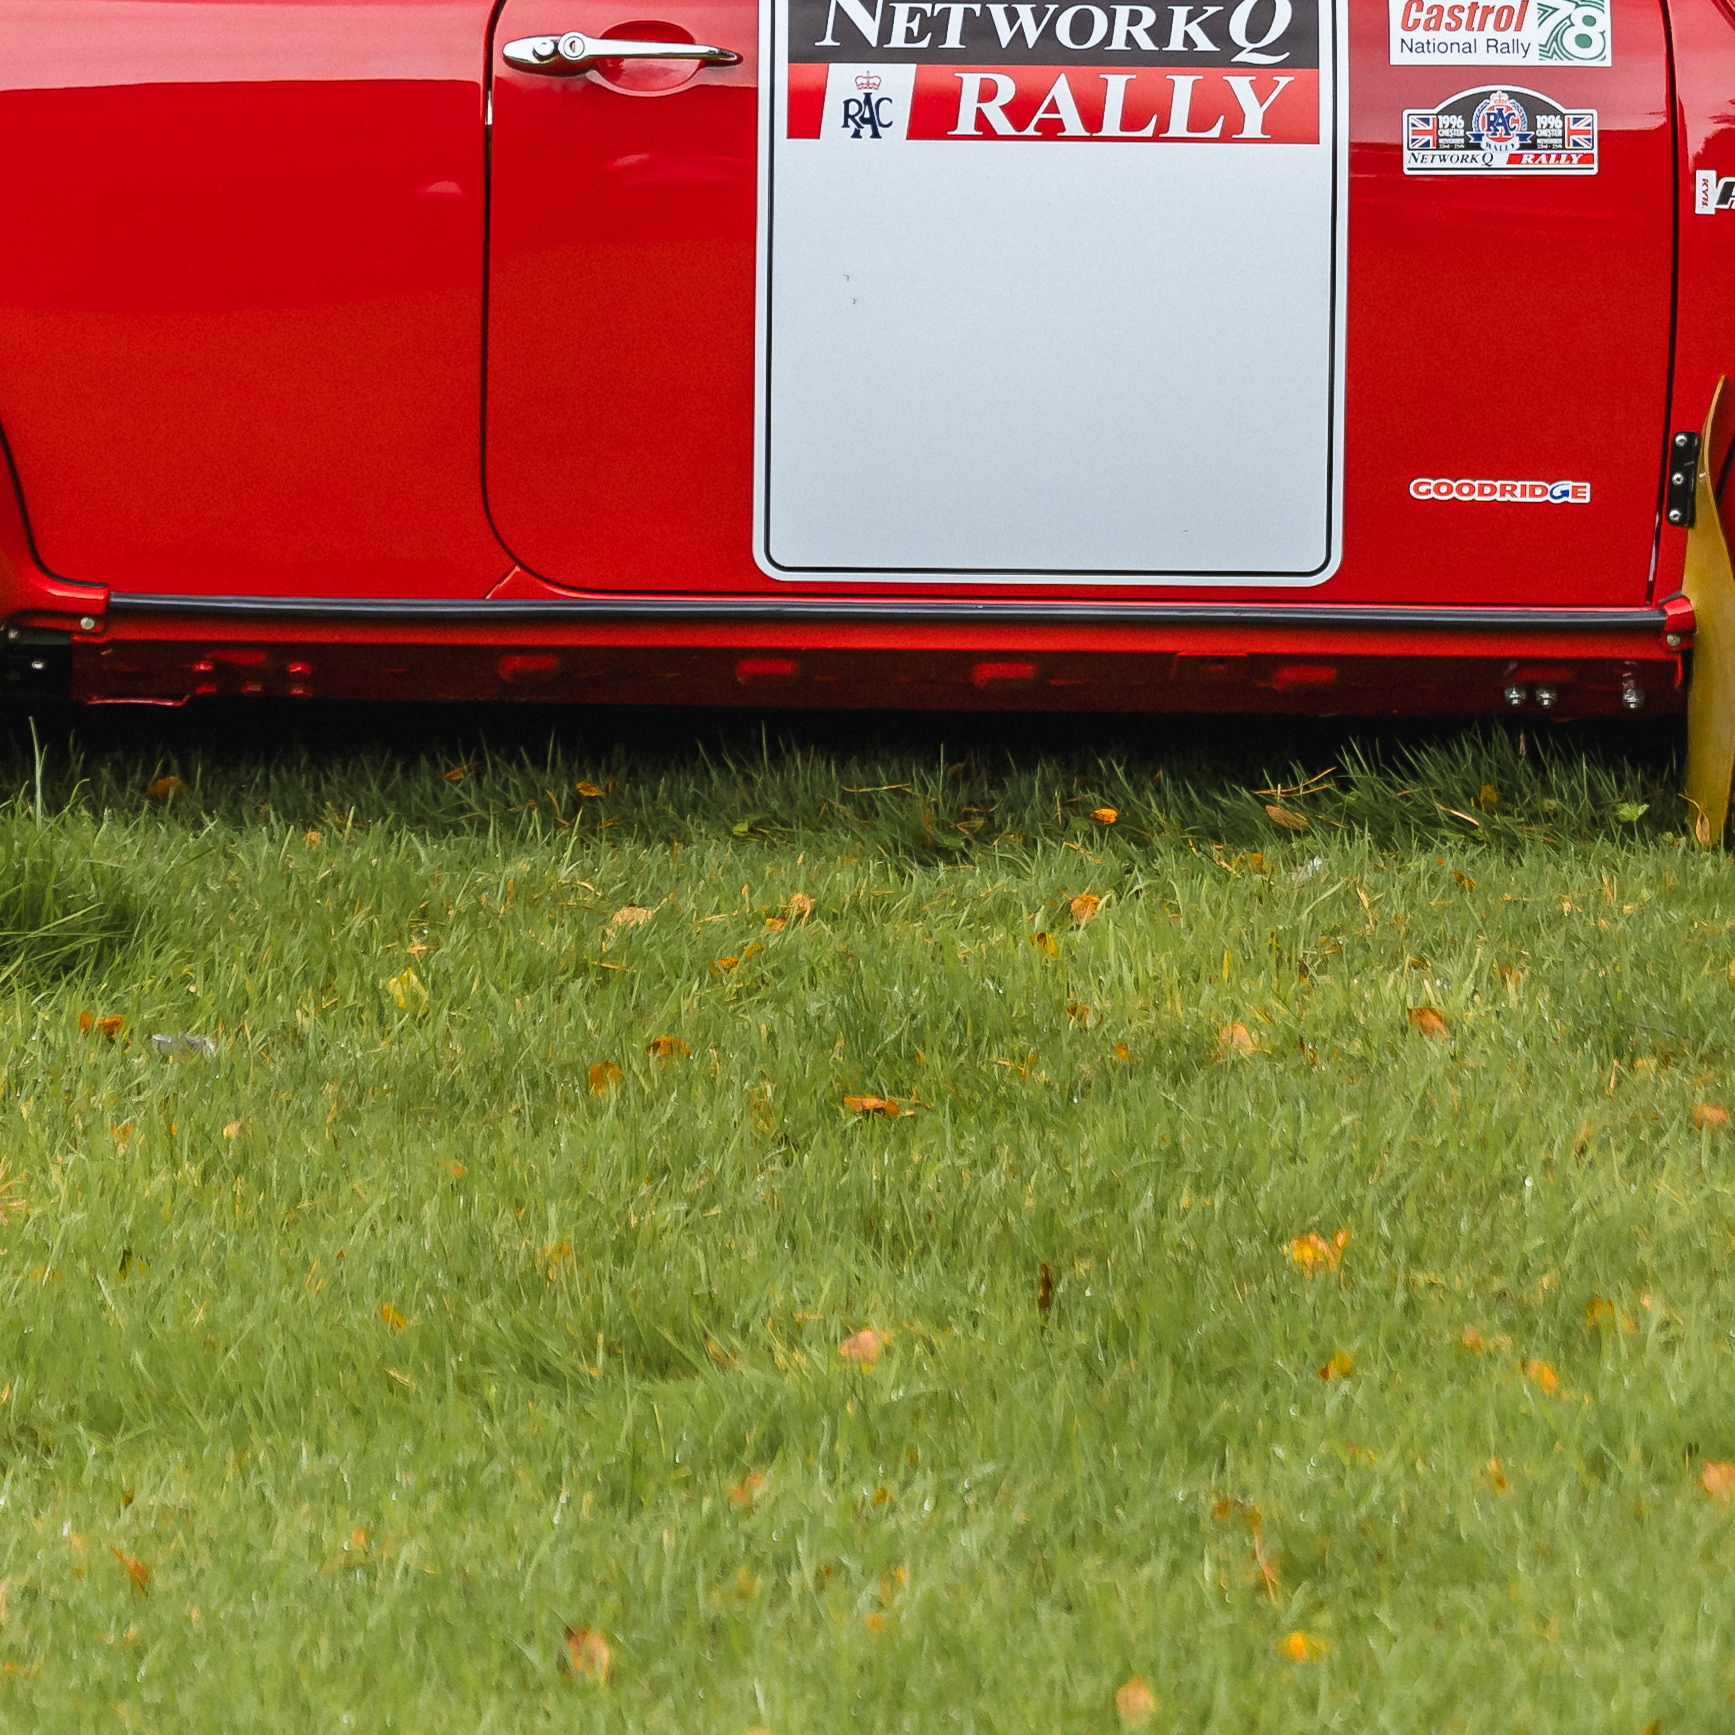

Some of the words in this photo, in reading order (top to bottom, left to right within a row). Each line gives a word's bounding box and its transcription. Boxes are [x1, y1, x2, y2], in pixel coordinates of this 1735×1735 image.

[1400, 38, 1477, 54] National
[1486, 38, 1531, 59] Rally
[841, 92, 893, 139] RAC
[947, 72, 1295, 138] RALLY
[1438, 115, 1465, 128] 1996
[1485, 107, 1516, 137] RAC
[1535, 115, 1563, 128] 1996
[1520, 154, 1583, 165] RALLY
[1412, 480, 1588, 501] GOODRIDGE
